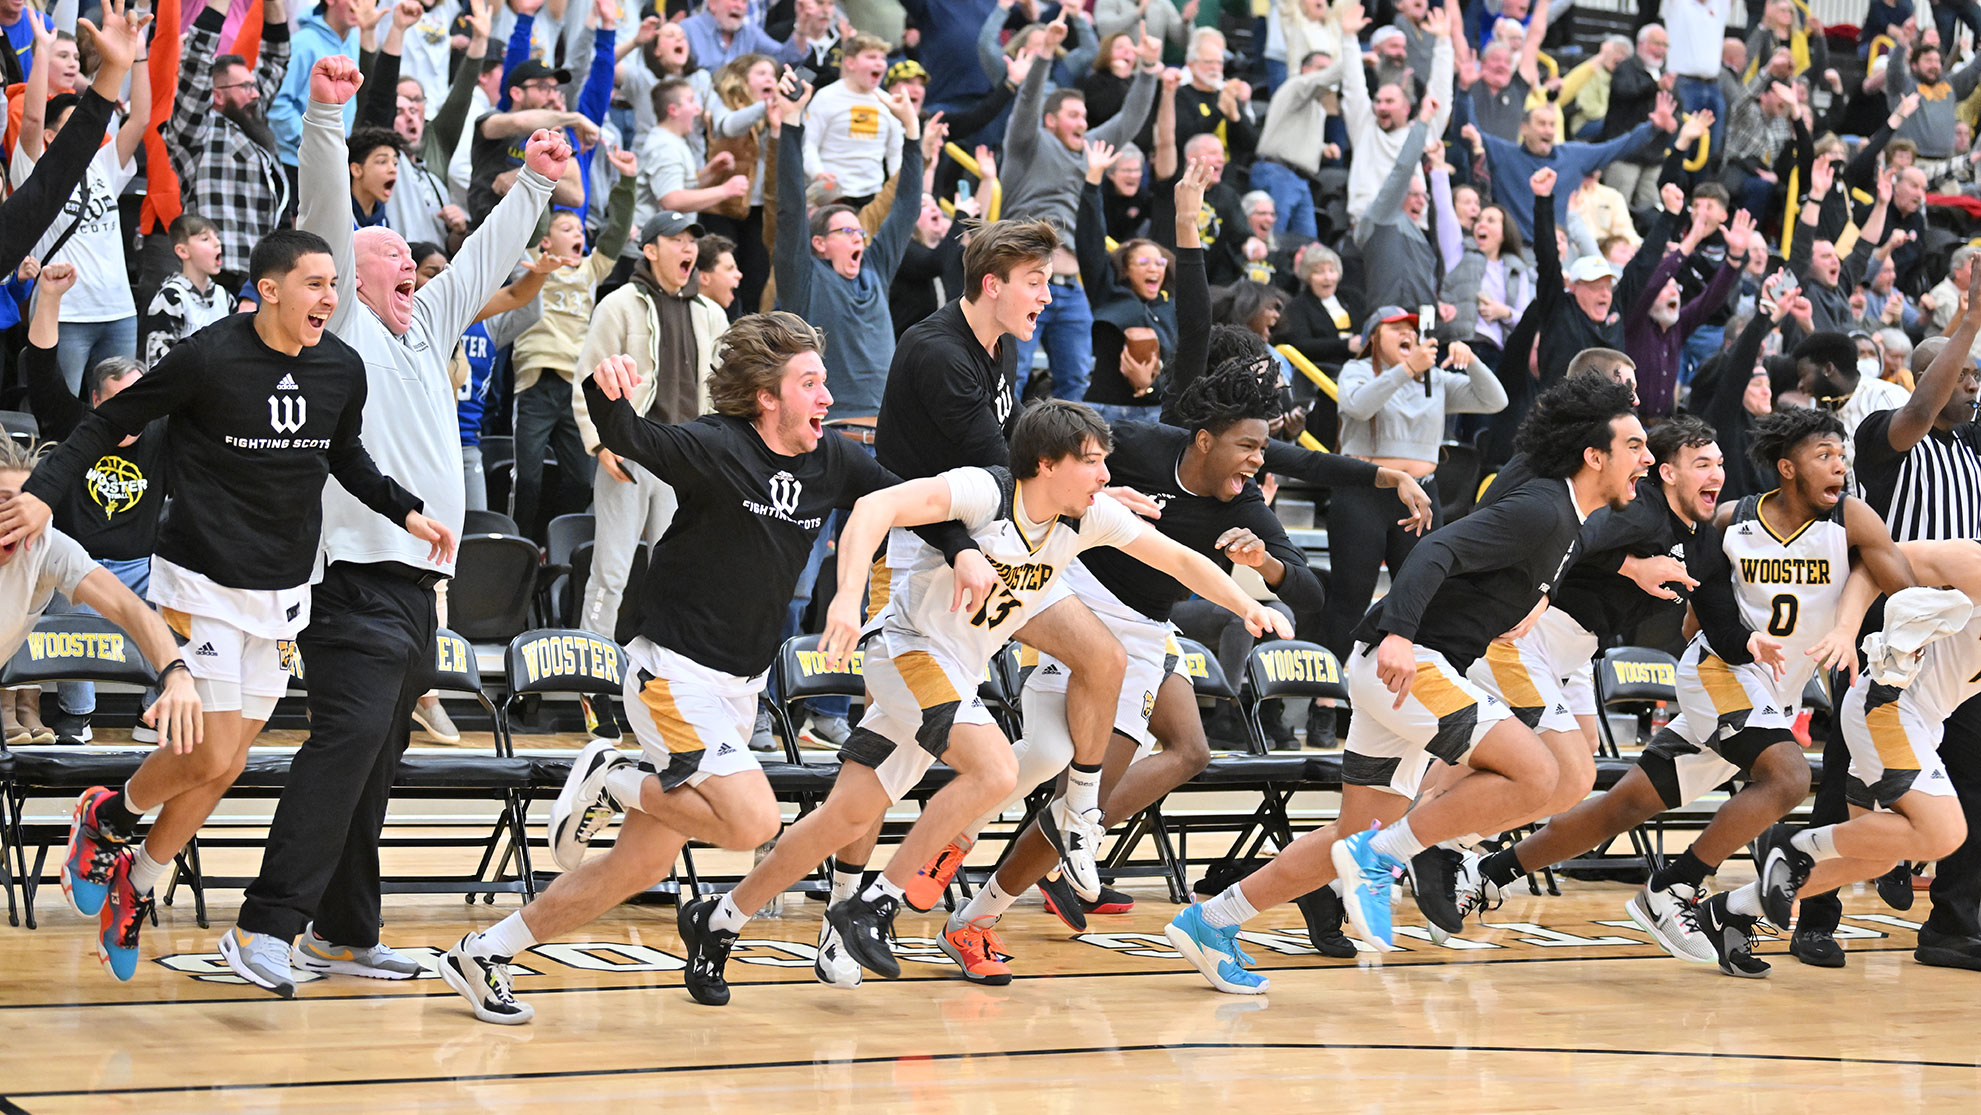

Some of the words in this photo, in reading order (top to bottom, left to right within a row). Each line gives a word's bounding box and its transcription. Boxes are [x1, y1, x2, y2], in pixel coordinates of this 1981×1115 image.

[551, 290, 583, 315] 33
[267, 394, 307, 434] W
[224, 435, 290, 449] FIGHTING
[292, 438, 331, 449] SCOTS
[85, 467, 148, 494] WOOSTER
[1740, 558, 1833, 585] WOOSTER
[1766, 592, 1800, 638] 0
[27, 631, 127, 663] WOOSTER
[521, 636, 621, 686] WOOSTER
[1258, 649, 1340, 684] WOOSTER
[1611, 660, 1677, 687] WOOSTER
